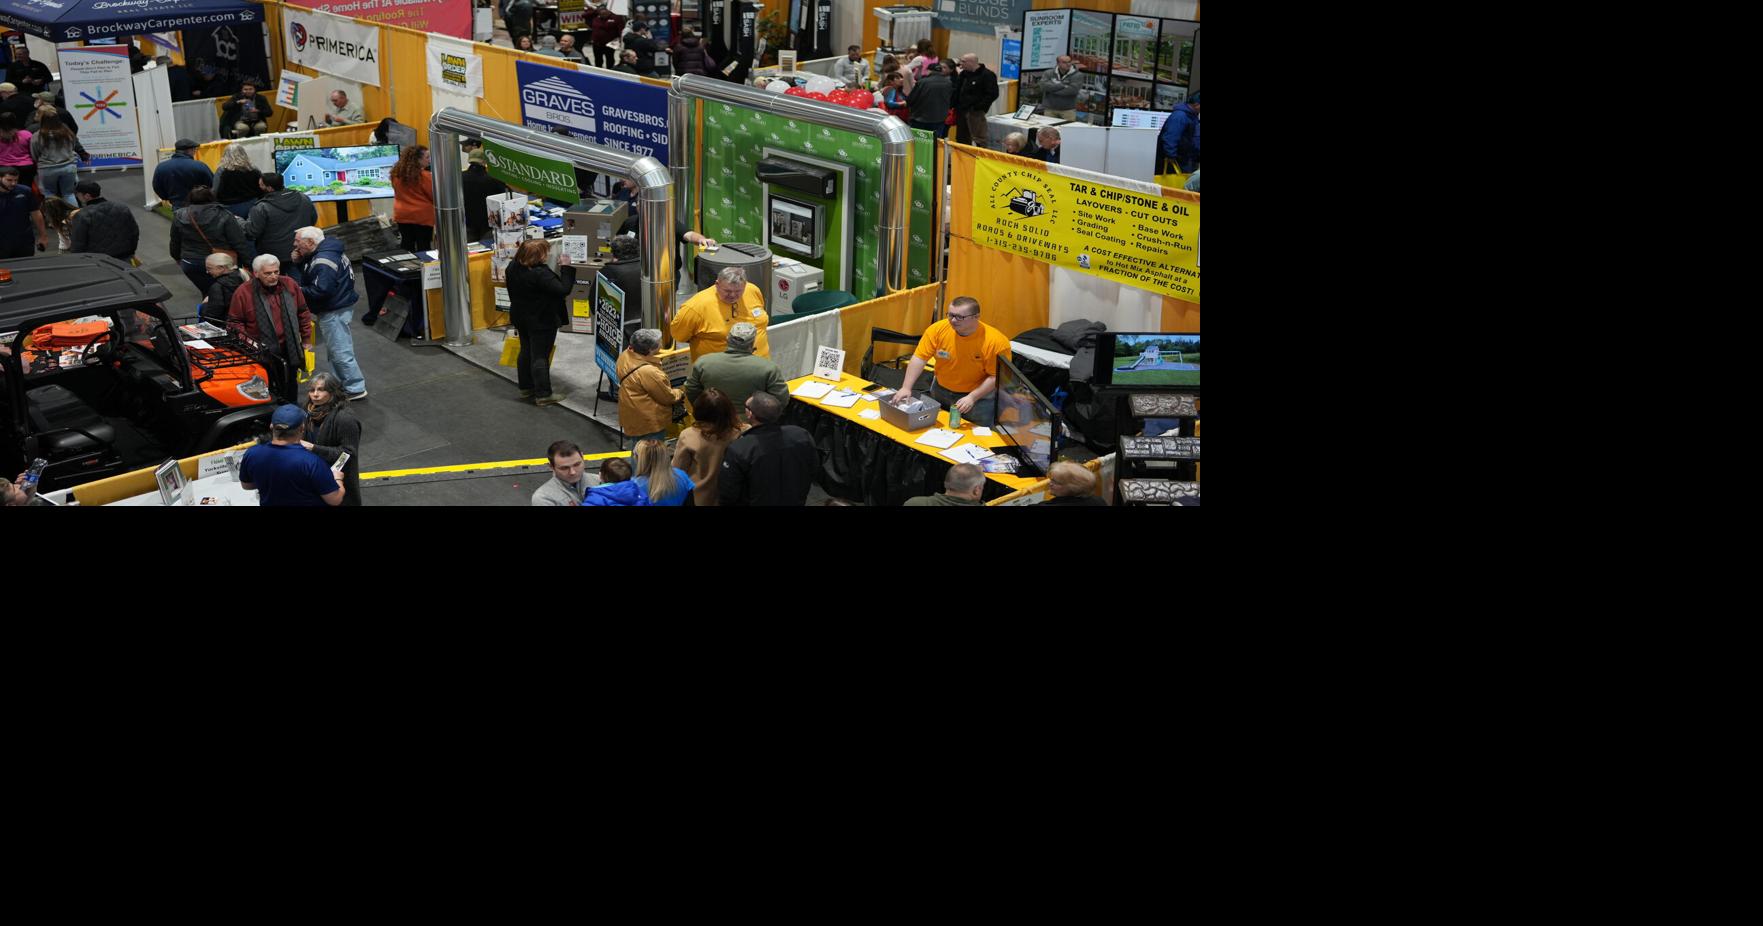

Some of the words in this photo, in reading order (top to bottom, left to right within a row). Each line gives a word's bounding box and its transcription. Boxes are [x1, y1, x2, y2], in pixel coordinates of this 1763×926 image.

[561, 14, 584, 23] WIN
[959, 2, 1008, 19] BLINDS
[88, 12, 235, 34] BrockwayCarpenter.com
[309, 34, 375, 63] PRIMERICA
[523, 88, 595, 116] GRAVES
[526, 120, 547, 132] Home
[602, 106, 668, 128] GRAVESBROS.
[603, 122, 644, 139] ROOFING
[274, 137, 314, 146] LAWN
[604, 138, 630, 151] SINCE
[632, 144, 653, 157] 1977
[499, 155, 574, 188] STANDARD
[992, 171, 1018, 192] COUNTY
[1021, 171, 1041, 182] CHIP
[1043, 184, 1056, 204] SEAL
[1050, 210, 1058, 224] LLC
[1070, 182, 1087, 194] TAR
[1090, 187, 1096, 196] &
[1100, 189, 1158, 210] CHIP/STONE
[1162, 203, 1169, 212] &
[1172, 205, 1190, 216] OIL
[1077, 198, 1122, 214] LAYOVERS
[1131, 210, 1149, 220] CUT
[1152, 215, 1178, 226] OUTS
[1078, 210, 1092, 219] Site
[1095, 214, 1116, 224] Work
[1023, 225, 1049, 237] SOLID
[1077, 218, 1108, 233] Grading
[1138, 224, 1159, 235] Base
[1161, 229, 1184, 240] Work
[977, 223, 1004, 236] ROADS
[1017, 234, 1069, 254] DRIVEWAYS
[1076, 227, 1093, 236] Seal
[1095, 232, 1126, 246] Coating
[1137, 233, 1192, 251] Crush-n-Run
[1091, 247, 1111, 256] COST
[1114, 252, 1157, 268] EFFECTIVE
[1136, 242, 1168, 255] Repairs
[1099, 265, 1138, 279] FRACTION
[1153, 278, 1169, 288] THE
[1170, 283, 1195, 295] COST!
[1115, 261, 1128, 270] Hot
[1130, 264, 1143, 273] Mix
[1145, 268, 1173, 281] Asphalt
[779, 292, 788, 300] LG
[601, 299, 616, 319] 2023
[596, 310, 623, 344] CHOICE
